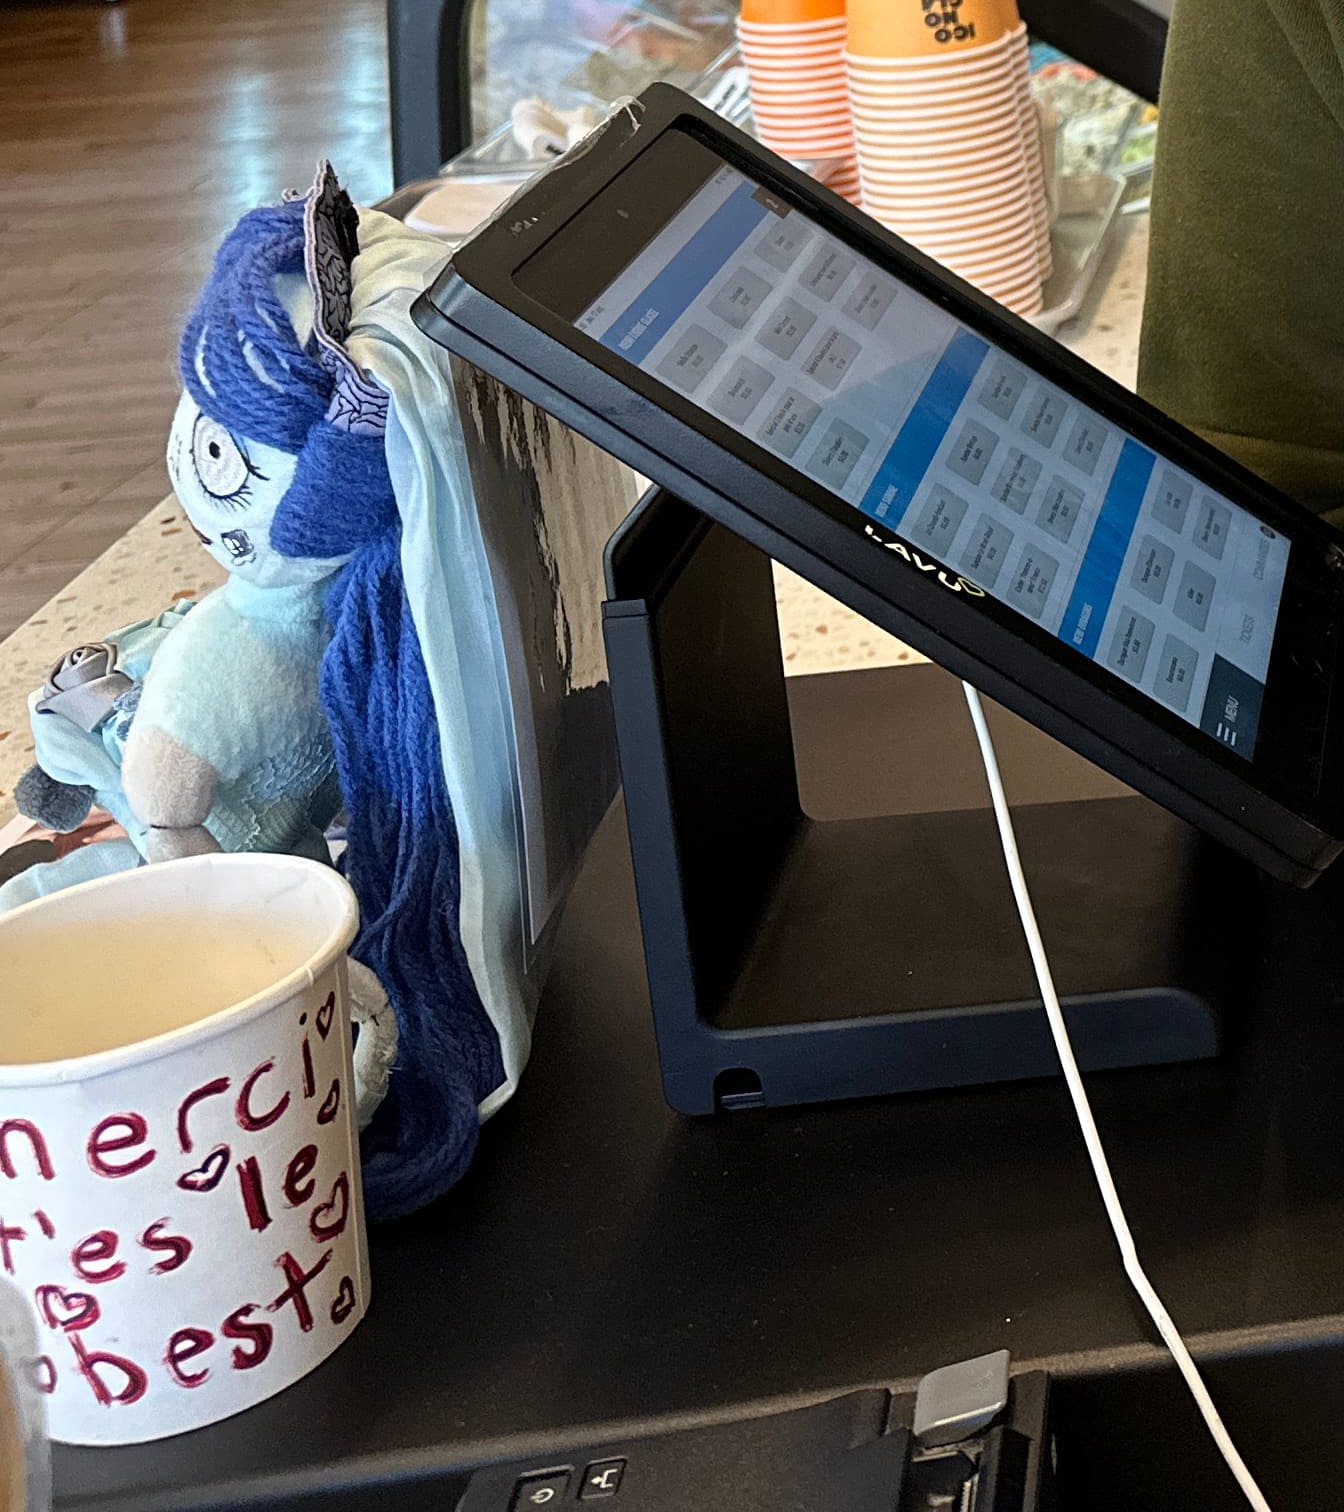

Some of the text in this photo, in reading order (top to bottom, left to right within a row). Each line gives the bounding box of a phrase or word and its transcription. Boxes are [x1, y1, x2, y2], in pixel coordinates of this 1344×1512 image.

[924, 10, 959, 28] NO
[934, 23, 976, 44] ICO
[764, 197, 779, 209] 2
[1223, 693, 1240, 724] MENU
[236, 1142, 319, 1233] le
[68, 1248, 334, 1408] best
